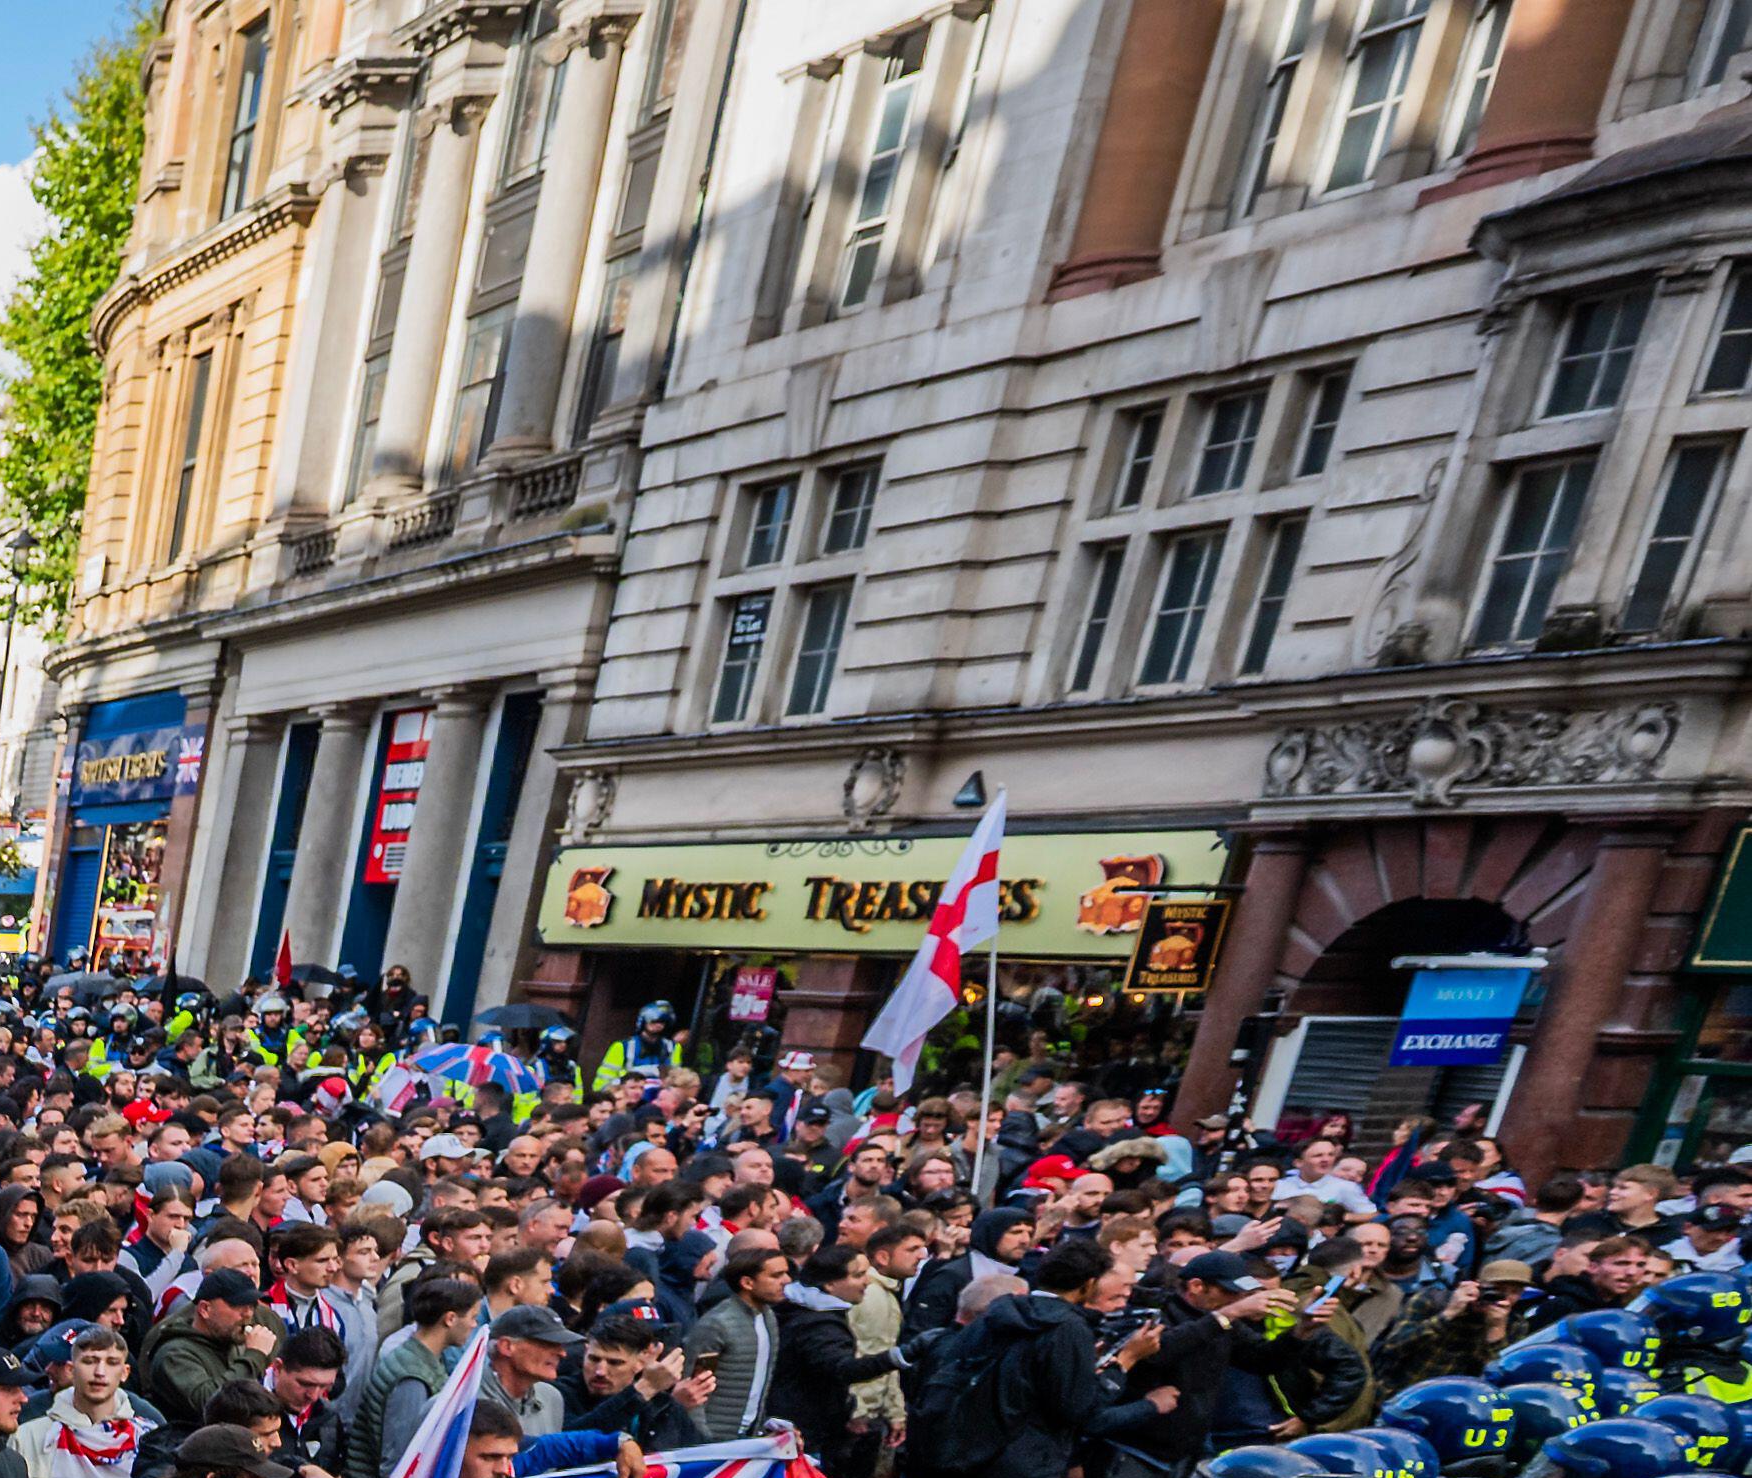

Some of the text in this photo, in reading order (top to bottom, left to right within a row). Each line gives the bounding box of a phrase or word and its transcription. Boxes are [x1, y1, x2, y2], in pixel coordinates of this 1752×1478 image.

[637, 875, 1048, 934] MYSTIC TREASES
[1401, 1033, 1502, 1051] EXCHANGE
